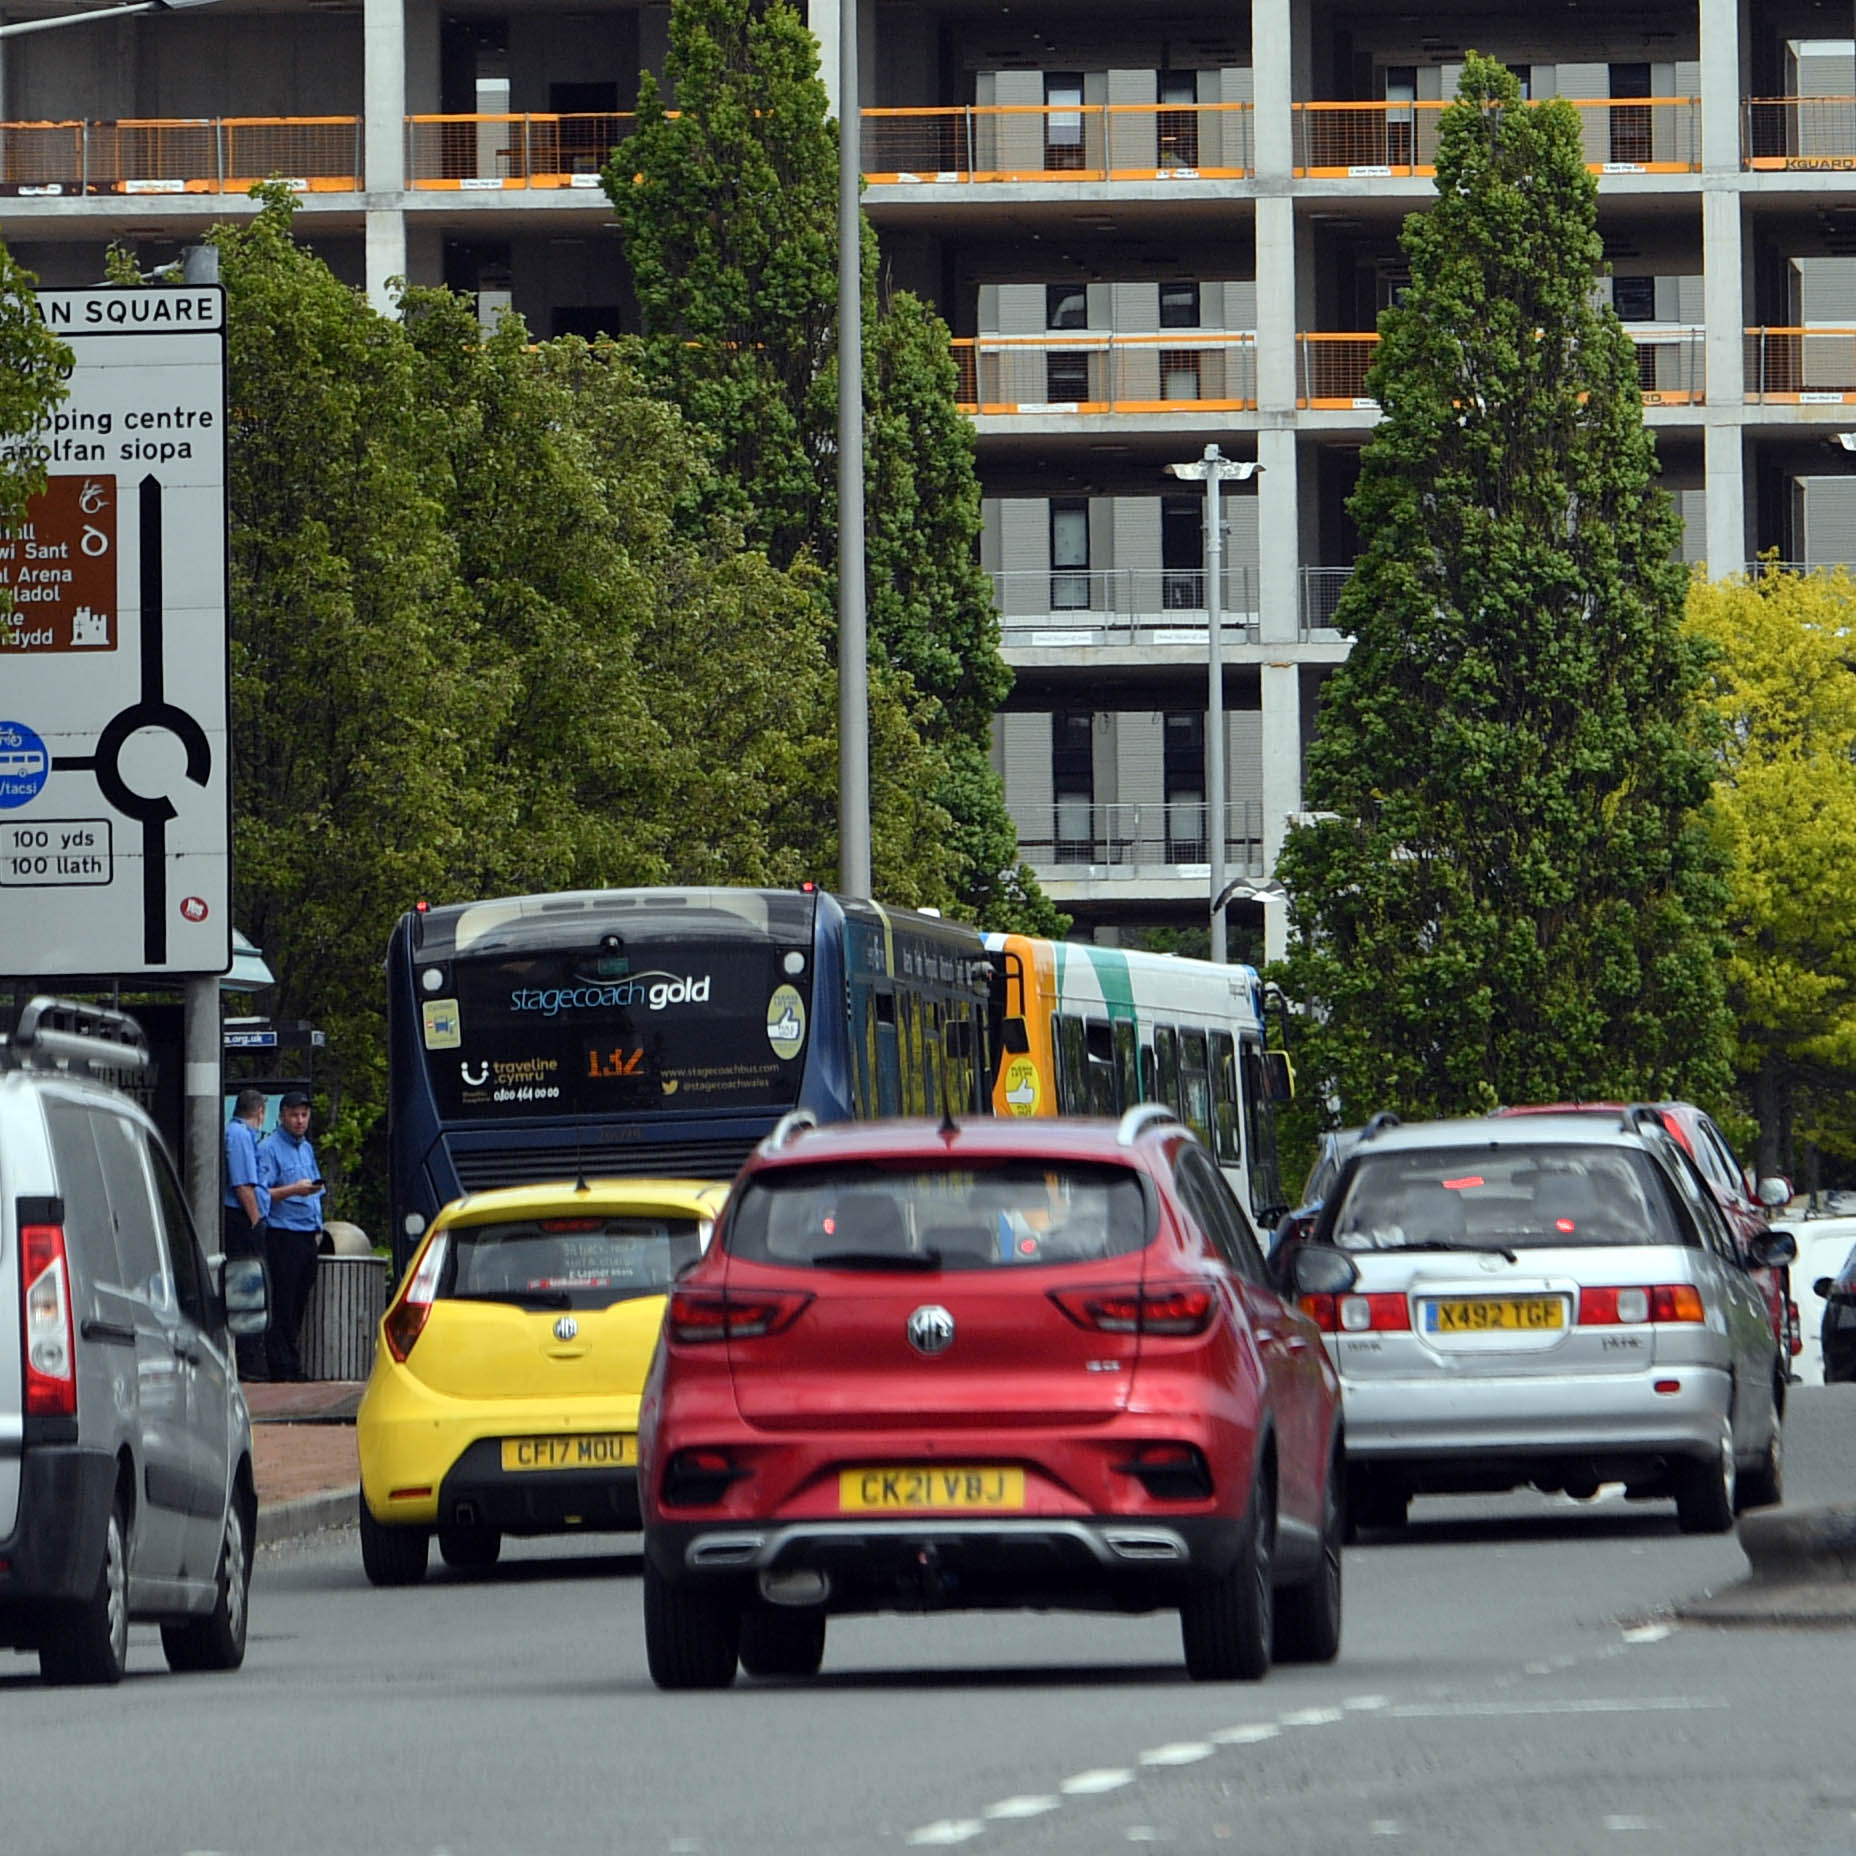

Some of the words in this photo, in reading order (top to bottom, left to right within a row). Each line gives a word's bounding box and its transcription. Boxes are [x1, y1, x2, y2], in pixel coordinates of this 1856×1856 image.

[1786, 159, 1854, 169] KGUARD
[85, 298, 213, 325] SQUARE
[124, 406, 213, 430] centre
[120, 438, 193, 464] siopa
[25, 542, 68, 559] Sant
[18, 566, 73, 583] Arena
[12, 831, 48, 847] 100
[61, 831, 94, 852] yds
[10, 858, 47, 874] 100
[57, 857, 101, 874] llath
[511, 980, 644, 1016] stagecoach
[649, 975, 711, 1010] gold
[493, 1058, 558, 1073] traveline
[495, 1071, 545, 1085] .cymru
[1440, 1302, 1503, 1330] X492
[1513, 1301, 1555, 1328] TGF
[518, 1440, 570, 1465] CF17
[577, 1438, 624, 1462] MOU
[860, 1471, 933, 1505] CK21
[943, 1470, 1004, 1504] VBJ
